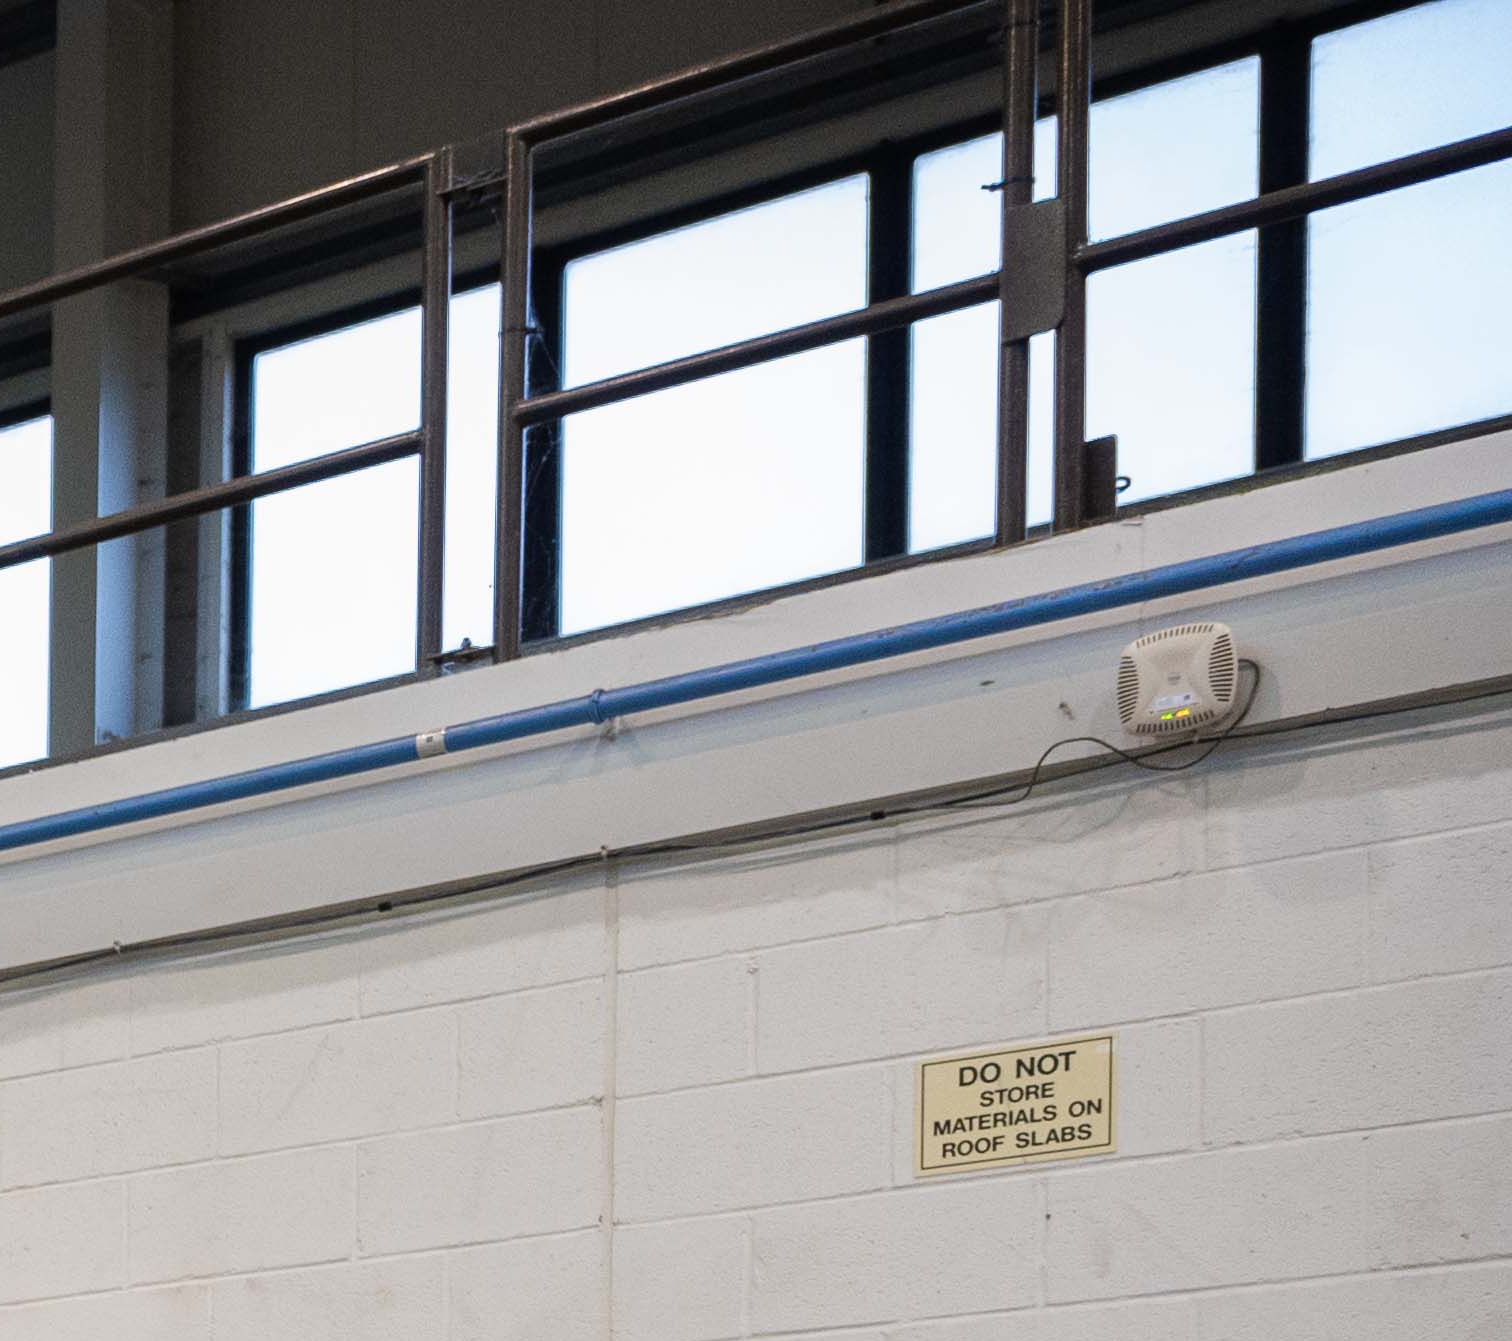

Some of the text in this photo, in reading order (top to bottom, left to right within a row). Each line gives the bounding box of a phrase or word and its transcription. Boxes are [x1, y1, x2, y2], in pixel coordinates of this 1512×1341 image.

[959, 1050, 1077, 1087] DO NOT
[980, 1082, 1055, 1108] STORE
[933, 1098, 1103, 1137] MATERIALS ON
[942, 1123, 1092, 1158] ROOF SLABS
